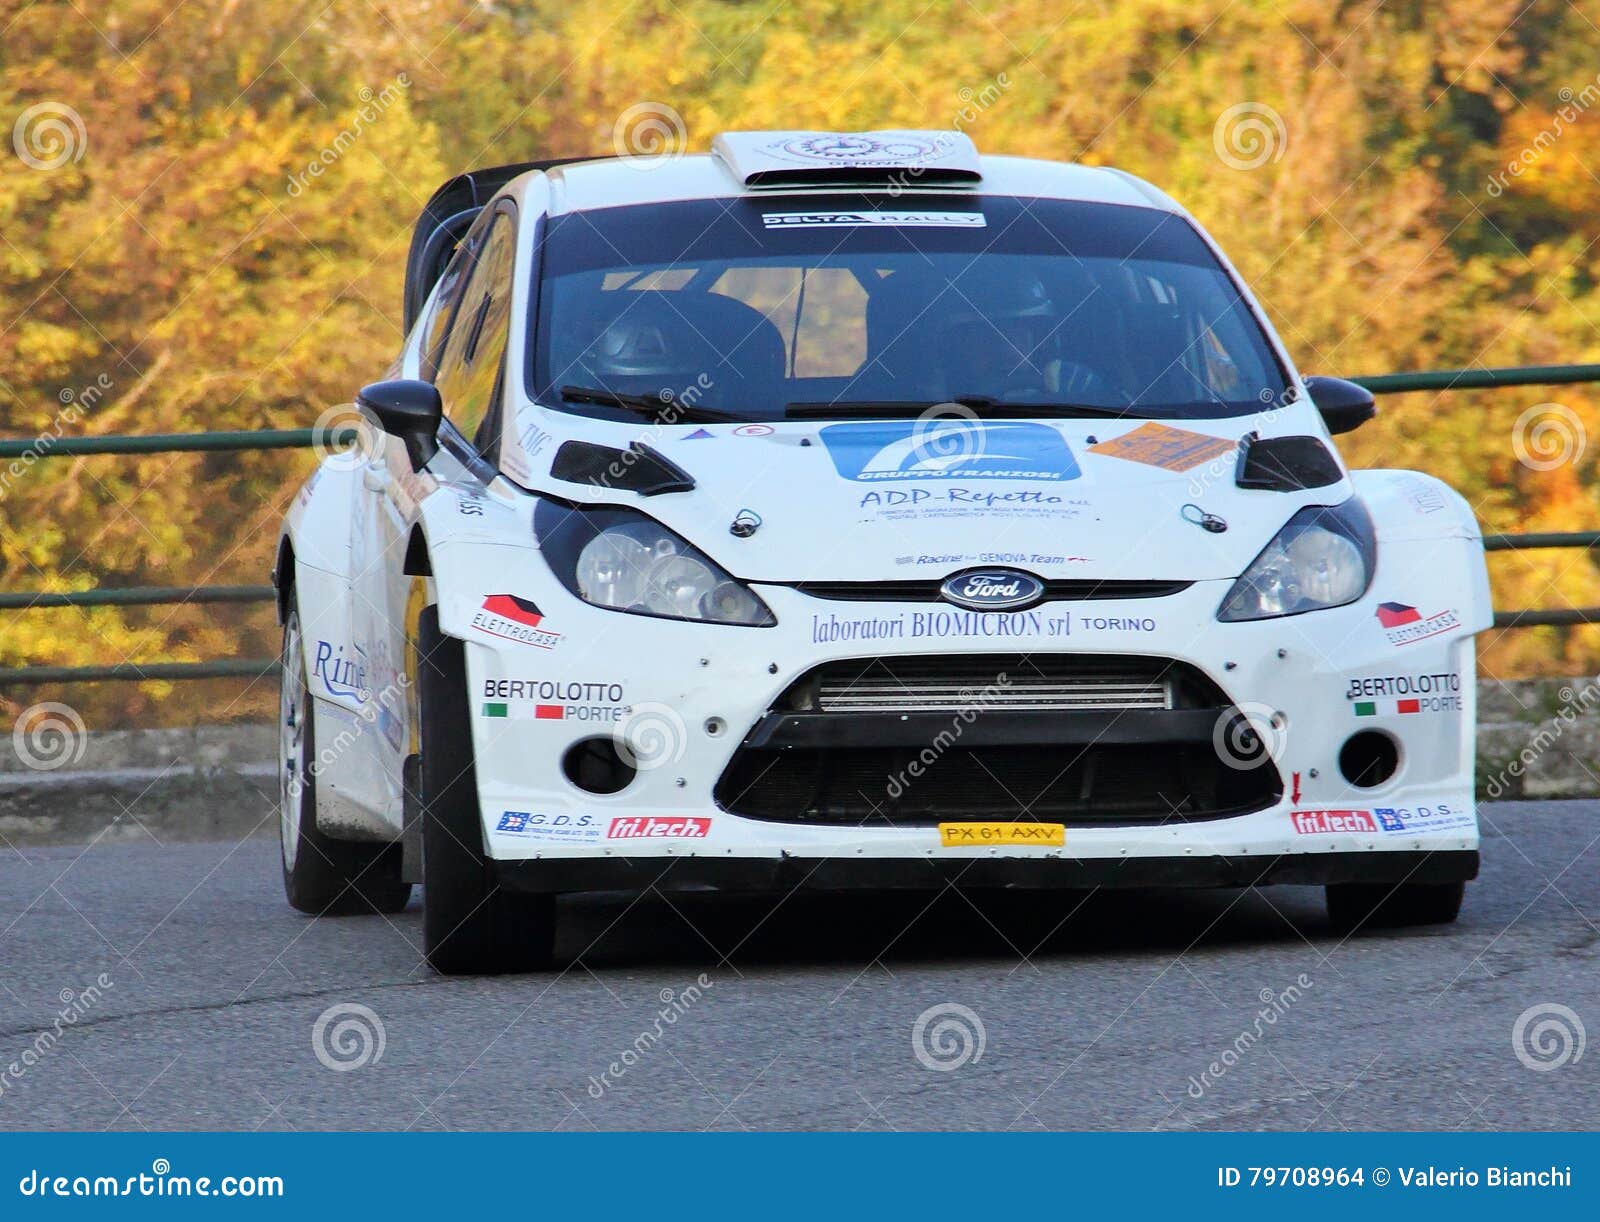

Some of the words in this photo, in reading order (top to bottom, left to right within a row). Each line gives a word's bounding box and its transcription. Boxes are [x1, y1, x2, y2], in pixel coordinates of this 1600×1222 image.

[763, 213, 857, 225] DELTA
[880, 214, 985, 223] RALLY
[857, 469, 944, 480] GRUPPO
[860, 488, 1062, 507] ADP-Repetto
[979, 552, 1026, 563] GENOVA
[1029, 553, 1065, 565] Team
[963, 575, 1019, 598] Ford
[472, 613, 560, 648] ELETTROCASA
[812, 612, 904, 644] laboratori
[911, 610, 1042, 638] BIOMICRON
[1048, 611, 1071, 637] srl
[1081, 616, 1156, 632] TORINO
[484, 679, 623, 702] BERTOLOTTO
[1350, 673, 1461, 697] BERTOLOTTO
[565, 704, 622, 722] PORTE
[946, 828, 975, 840] PX
[980, 827, 1003, 839] 61
[1011, 827, 1056, 839] AXV
